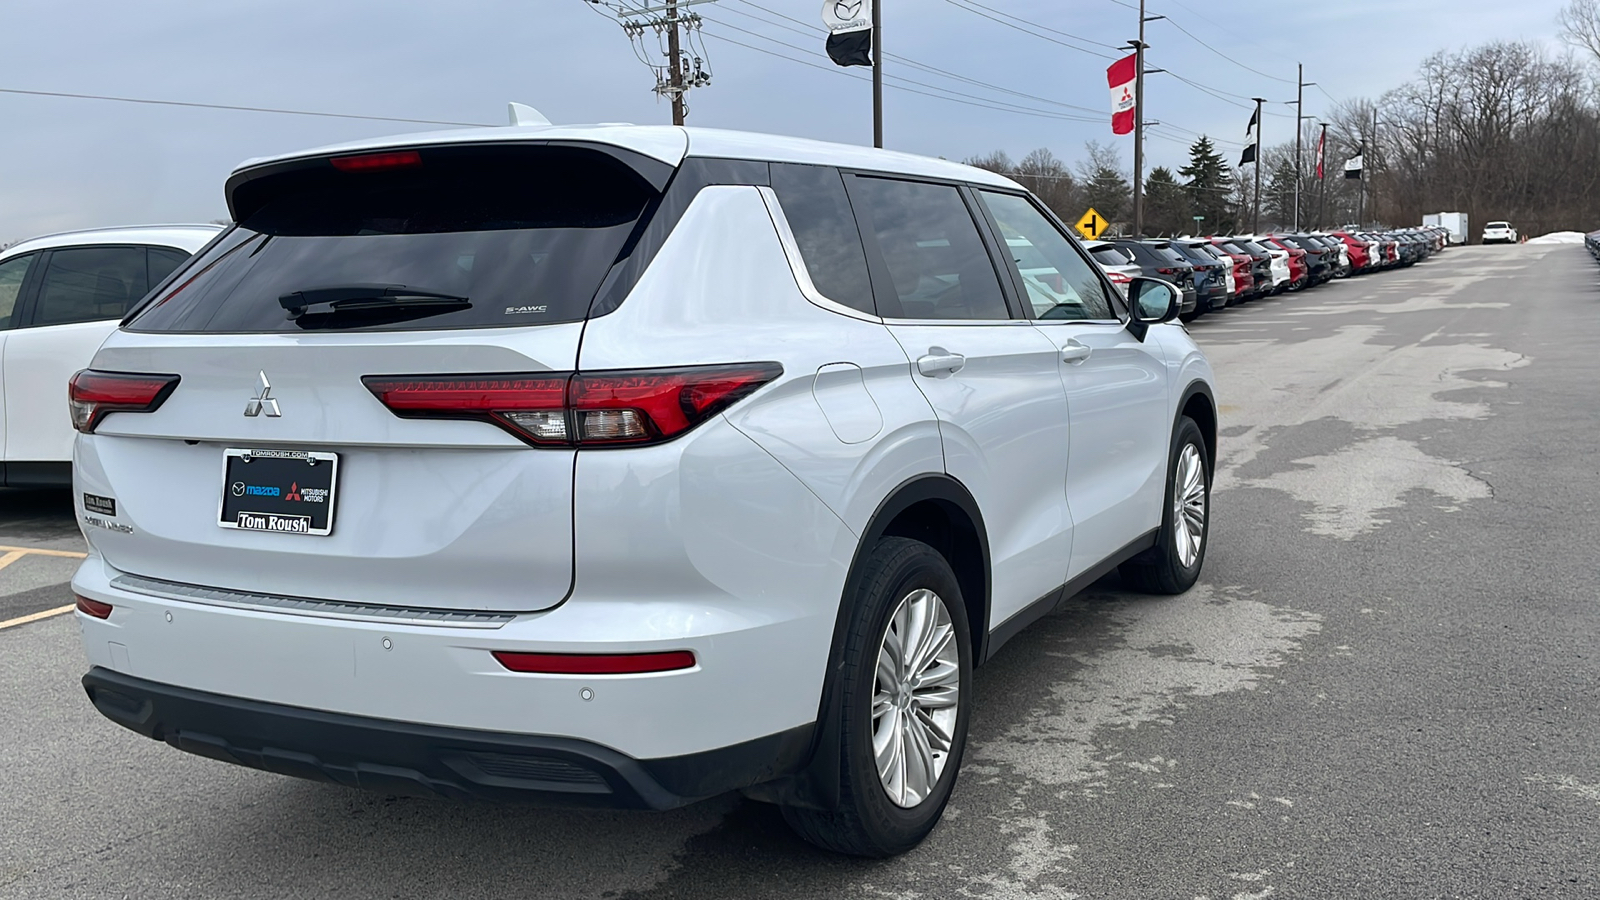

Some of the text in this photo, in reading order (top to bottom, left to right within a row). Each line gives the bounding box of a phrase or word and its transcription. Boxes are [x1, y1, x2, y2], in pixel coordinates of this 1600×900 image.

[251, 450, 308, 459] TOMROUSH.COM
[300, 488, 328, 496] MITSUBISHI
[303, 495, 324, 503] MOTORS
[240, 514, 308, 532] Tom Roush
